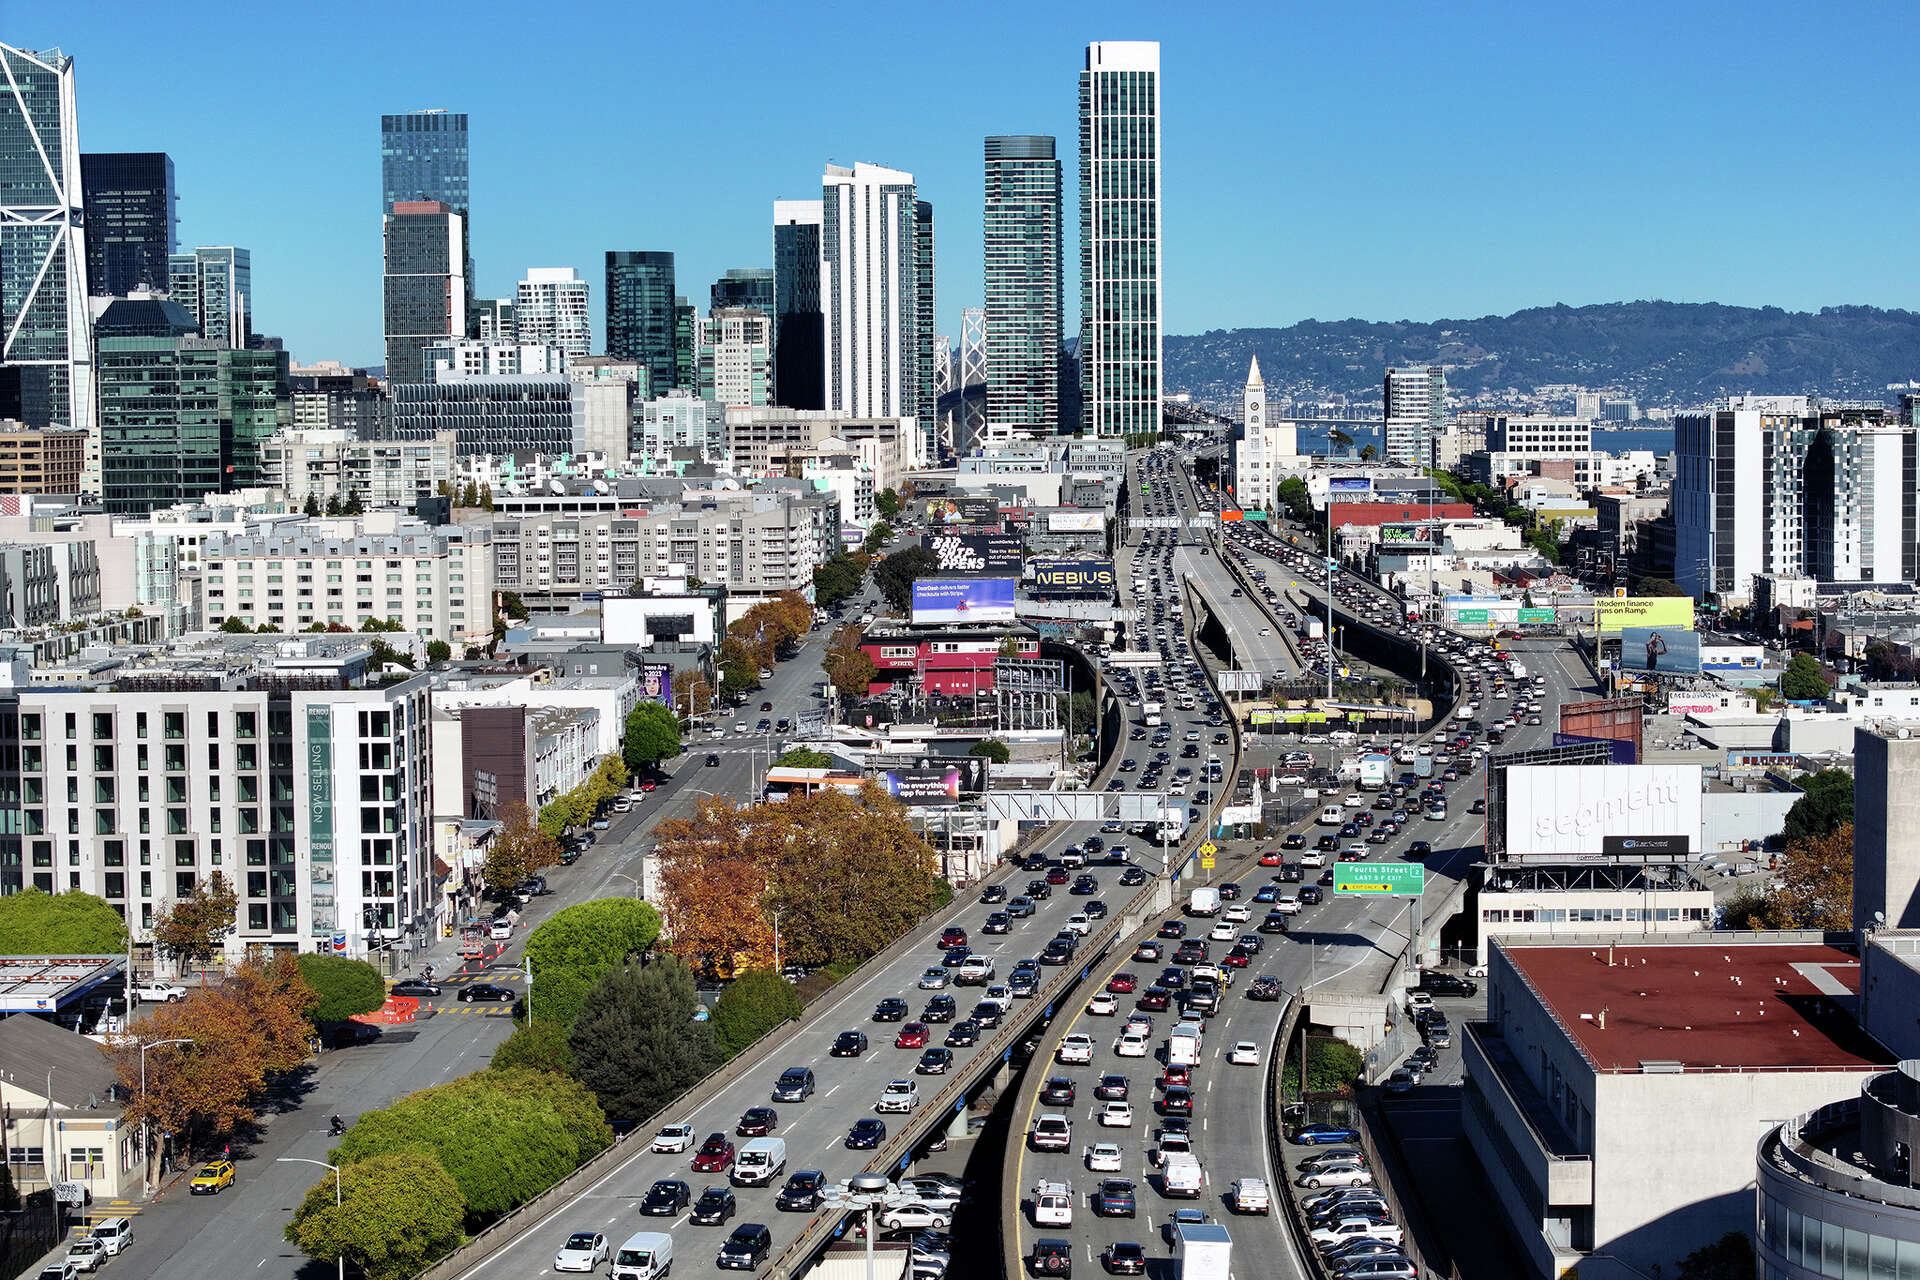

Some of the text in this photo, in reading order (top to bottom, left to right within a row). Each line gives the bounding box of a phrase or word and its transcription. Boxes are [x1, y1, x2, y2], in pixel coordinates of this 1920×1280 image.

[1036, 571, 1112, 585] NEBIUS
[1625, 607, 1648, 615] Ramp.
[312, 744, 323, 823] NOW SELLING
[911, 782, 950, 791] everything
[1535, 776, 1679, 838] segment
